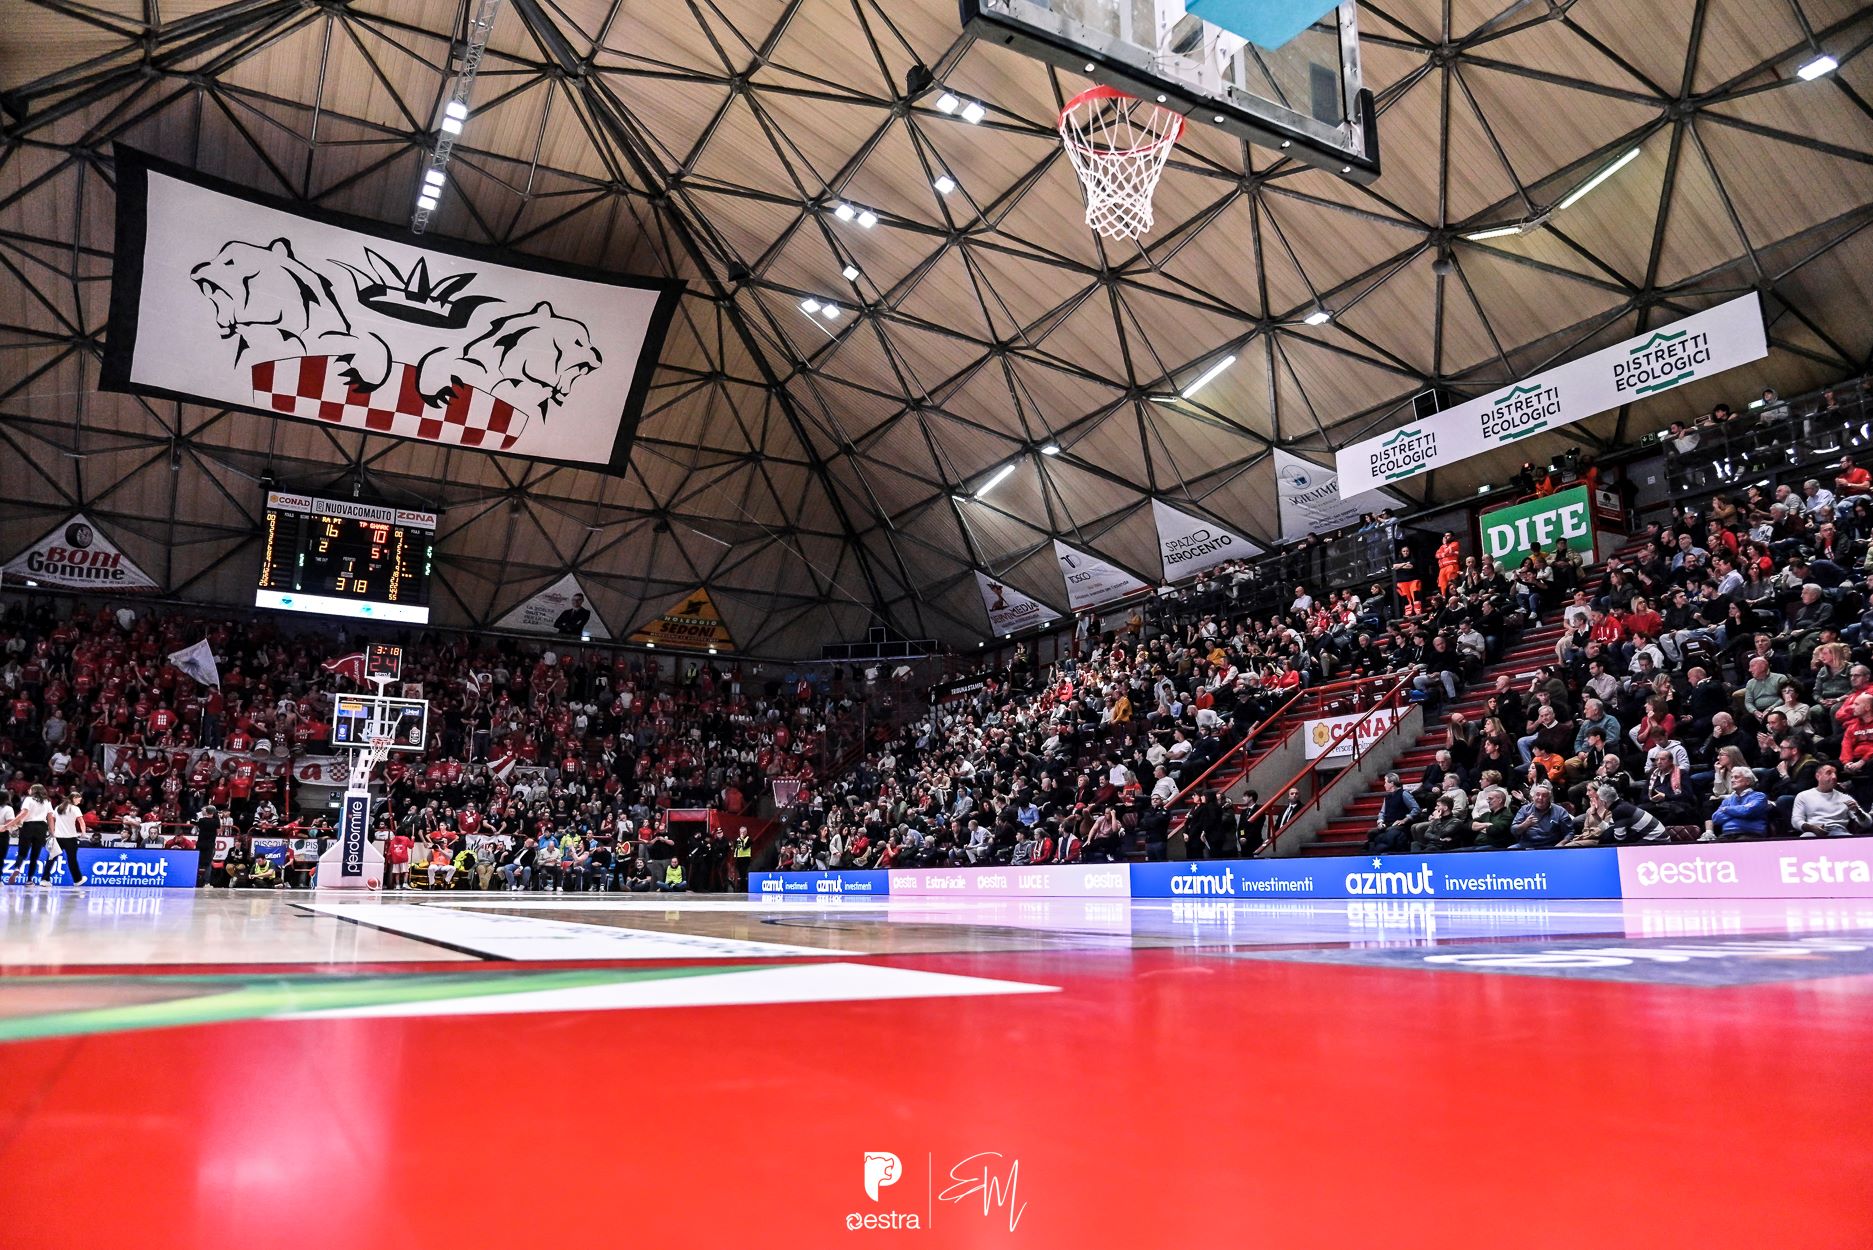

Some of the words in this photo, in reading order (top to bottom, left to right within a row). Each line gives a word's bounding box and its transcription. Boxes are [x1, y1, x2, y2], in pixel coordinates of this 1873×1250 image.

[1614, 333, 1707, 377] DISTRETTI
[1616, 348, 1710, 392] ECOLOGICI
[1481, 387, 1558, 425] DISTRETTI
[1483, 401, 1560, 438] ECOLOGICI
[1371, 432, 1436, 465] DISTRETTI
[1372, 445, 1437, 477] ECOLOGICI
[279, 497, 310, 507] CONAD
[325, 502, 392, 521] NUOVACOMAUTO
[397, 511, 435, 524] ZONA
[326, 524, 338, 537] 16
[373, 530, 386, 543] 10
[1487, 502, 1587, 558] DIFE
[319, 541, 328, 552] 2
[1164, 535, 1232, 565] ZEROCENTO
[1165, 529, 1210, 552] SPAZIO
[46, 547, 122, 568] BONI
[371, 547, 380, 559] 5
[27, 551, 125, 580] Gomme
[348, 561, 353, 572] 1
[660, 622, 716, 637] SEDONI
[664, 615, 717, 626] NOLEGGIO
[376, 645, 400, 656] 3:18
[370, 655, 397, 672] 24
[347, 801, 363, 873] perdormire
[92, 857, 168, 876] azimut
[1665, 856, 1739, 884] estra
[91, 875, 164, 886] investimenti
[762, 875, 784, 892] azimut
[816, 874, 842, 892] azimut
[844, 881, 872, 891] investimenti
[1019, 874, 1043, 889] LUCE
[1171, 867, 1235, 894] azimut
[1242, 876, 1313, 892] investimenti
[1345, 862, 1434, 894] azimut
[1445, 872, 1547, 891] investimenti
